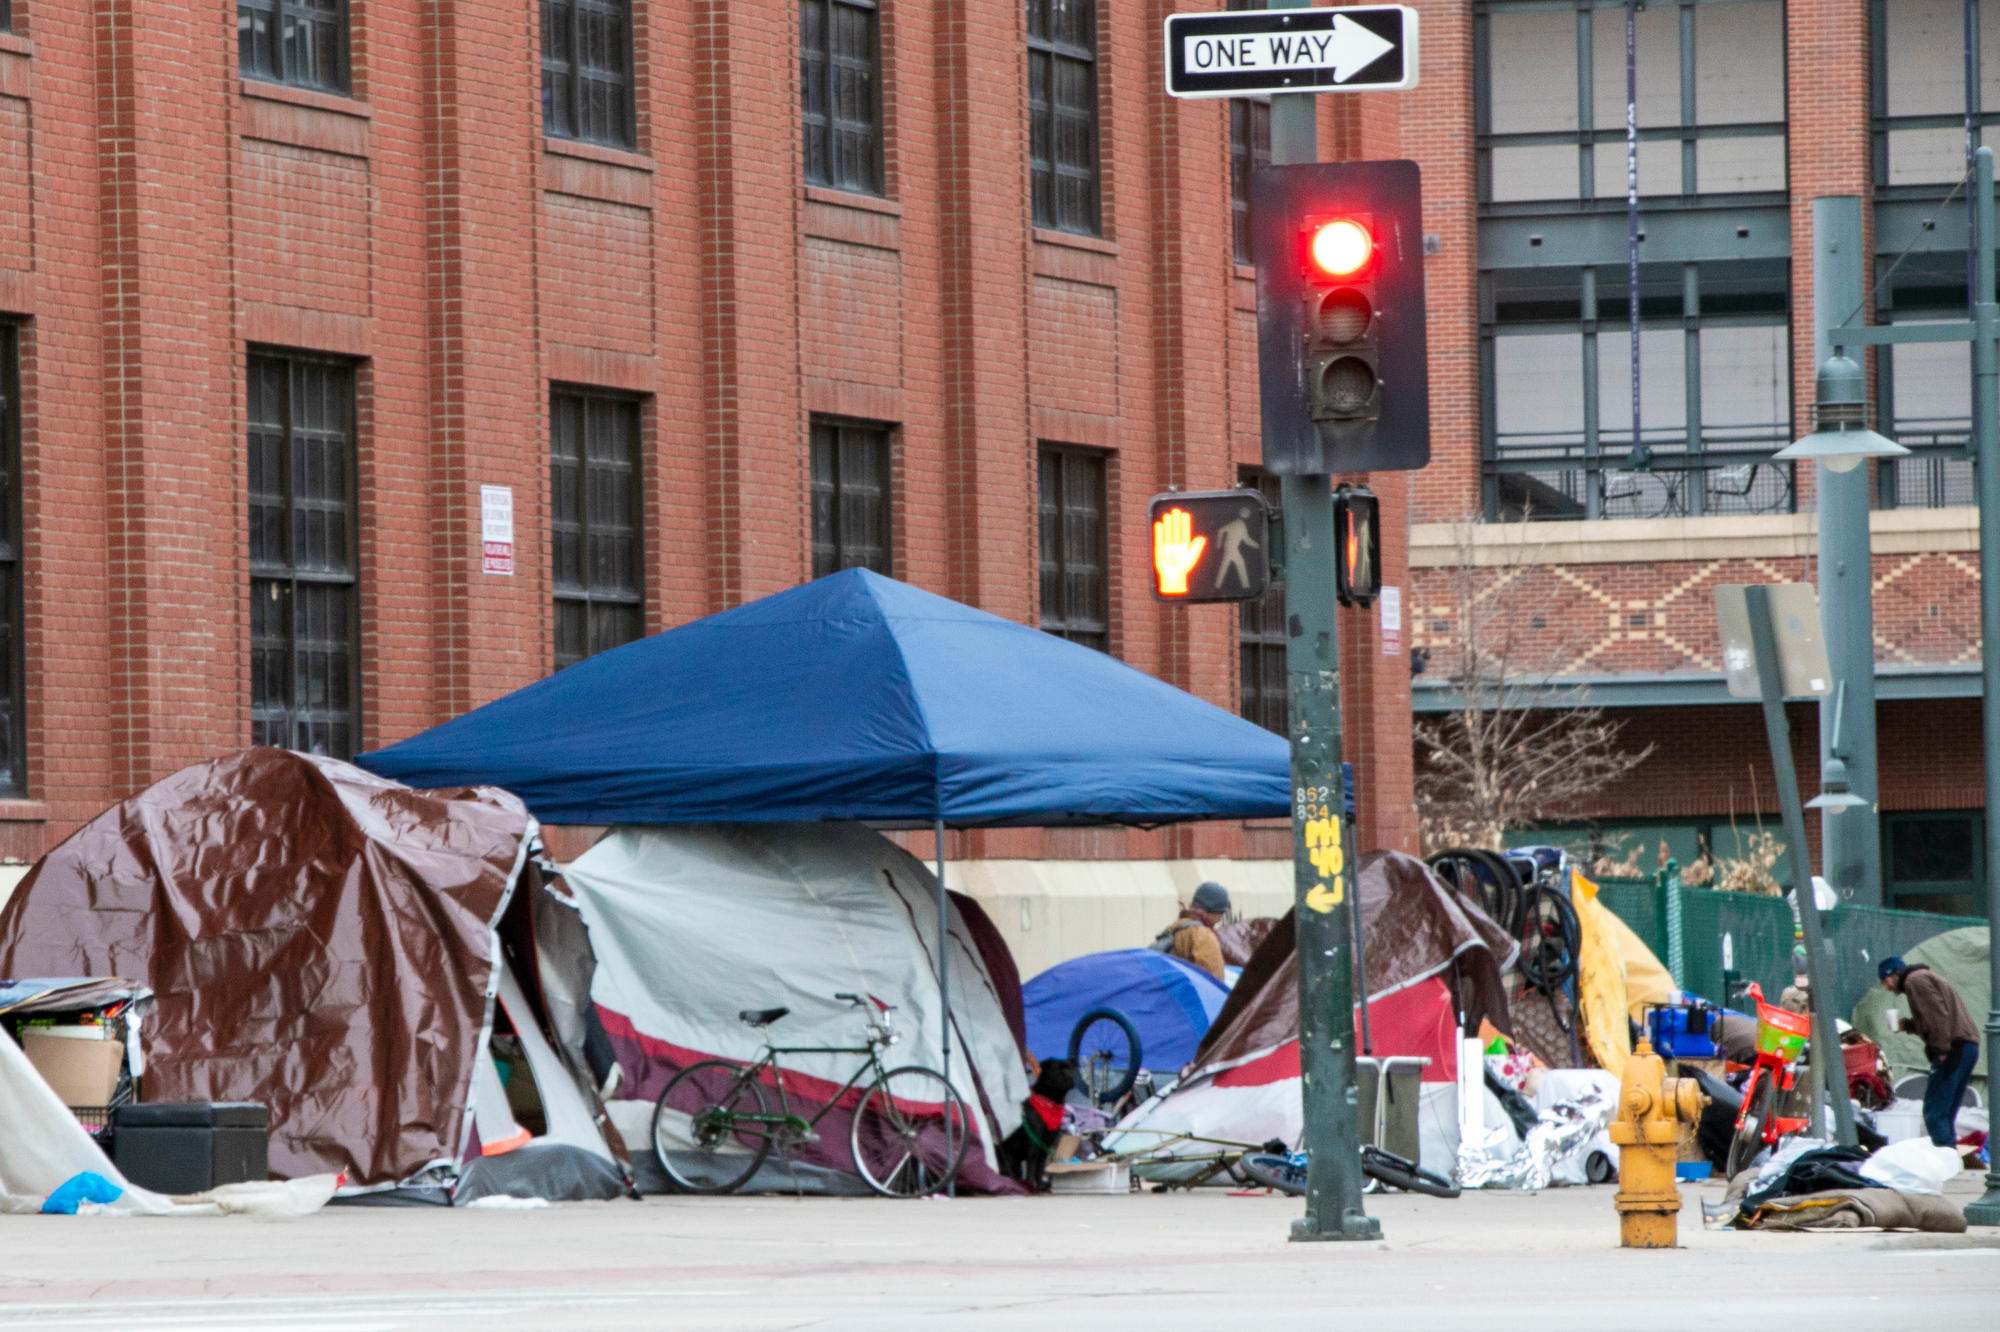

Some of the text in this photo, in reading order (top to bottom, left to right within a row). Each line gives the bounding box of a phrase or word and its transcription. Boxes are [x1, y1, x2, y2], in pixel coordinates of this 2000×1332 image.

[1195, 35, 1332, 68] ONE WAY
[1628, 103, 1636, 205] WALKER
[1296, 786, 1329, 803] 862
[1297, 804, 1329, 820] 834
